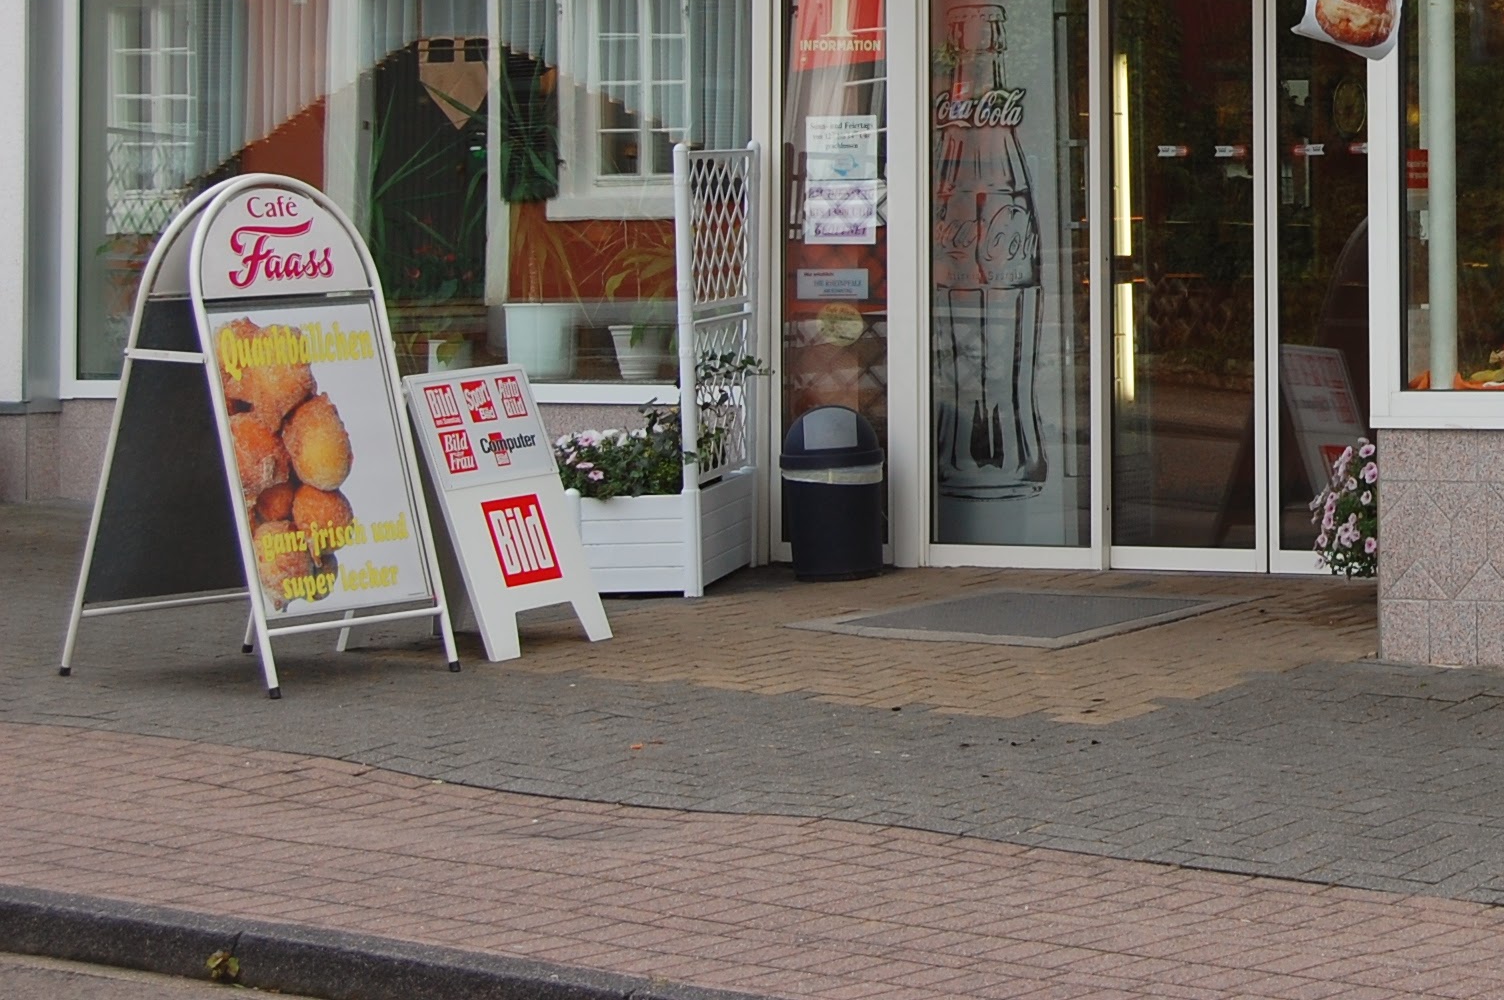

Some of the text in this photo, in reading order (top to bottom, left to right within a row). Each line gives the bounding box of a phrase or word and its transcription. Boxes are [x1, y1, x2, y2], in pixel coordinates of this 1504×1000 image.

[800, 39, 882, 52] INFORMATION
[246, 195, 299, 219] Café
[228, 217, 335, 289] Faass
[219, 320, 375, 382] Quarkbällchen
[426, 387, 460, 419] Bild
[463, 381, 491, 412] Sport
[444, 431, 469, 453] Bild
[480, 433, 536, 454] Computer
[449, 452, 476, 471] Frau
[262, 511, 410, 562] ganz frisch und
[488, 504, 555, 576] Bild
[282, 559, 399, 603] super lecker
